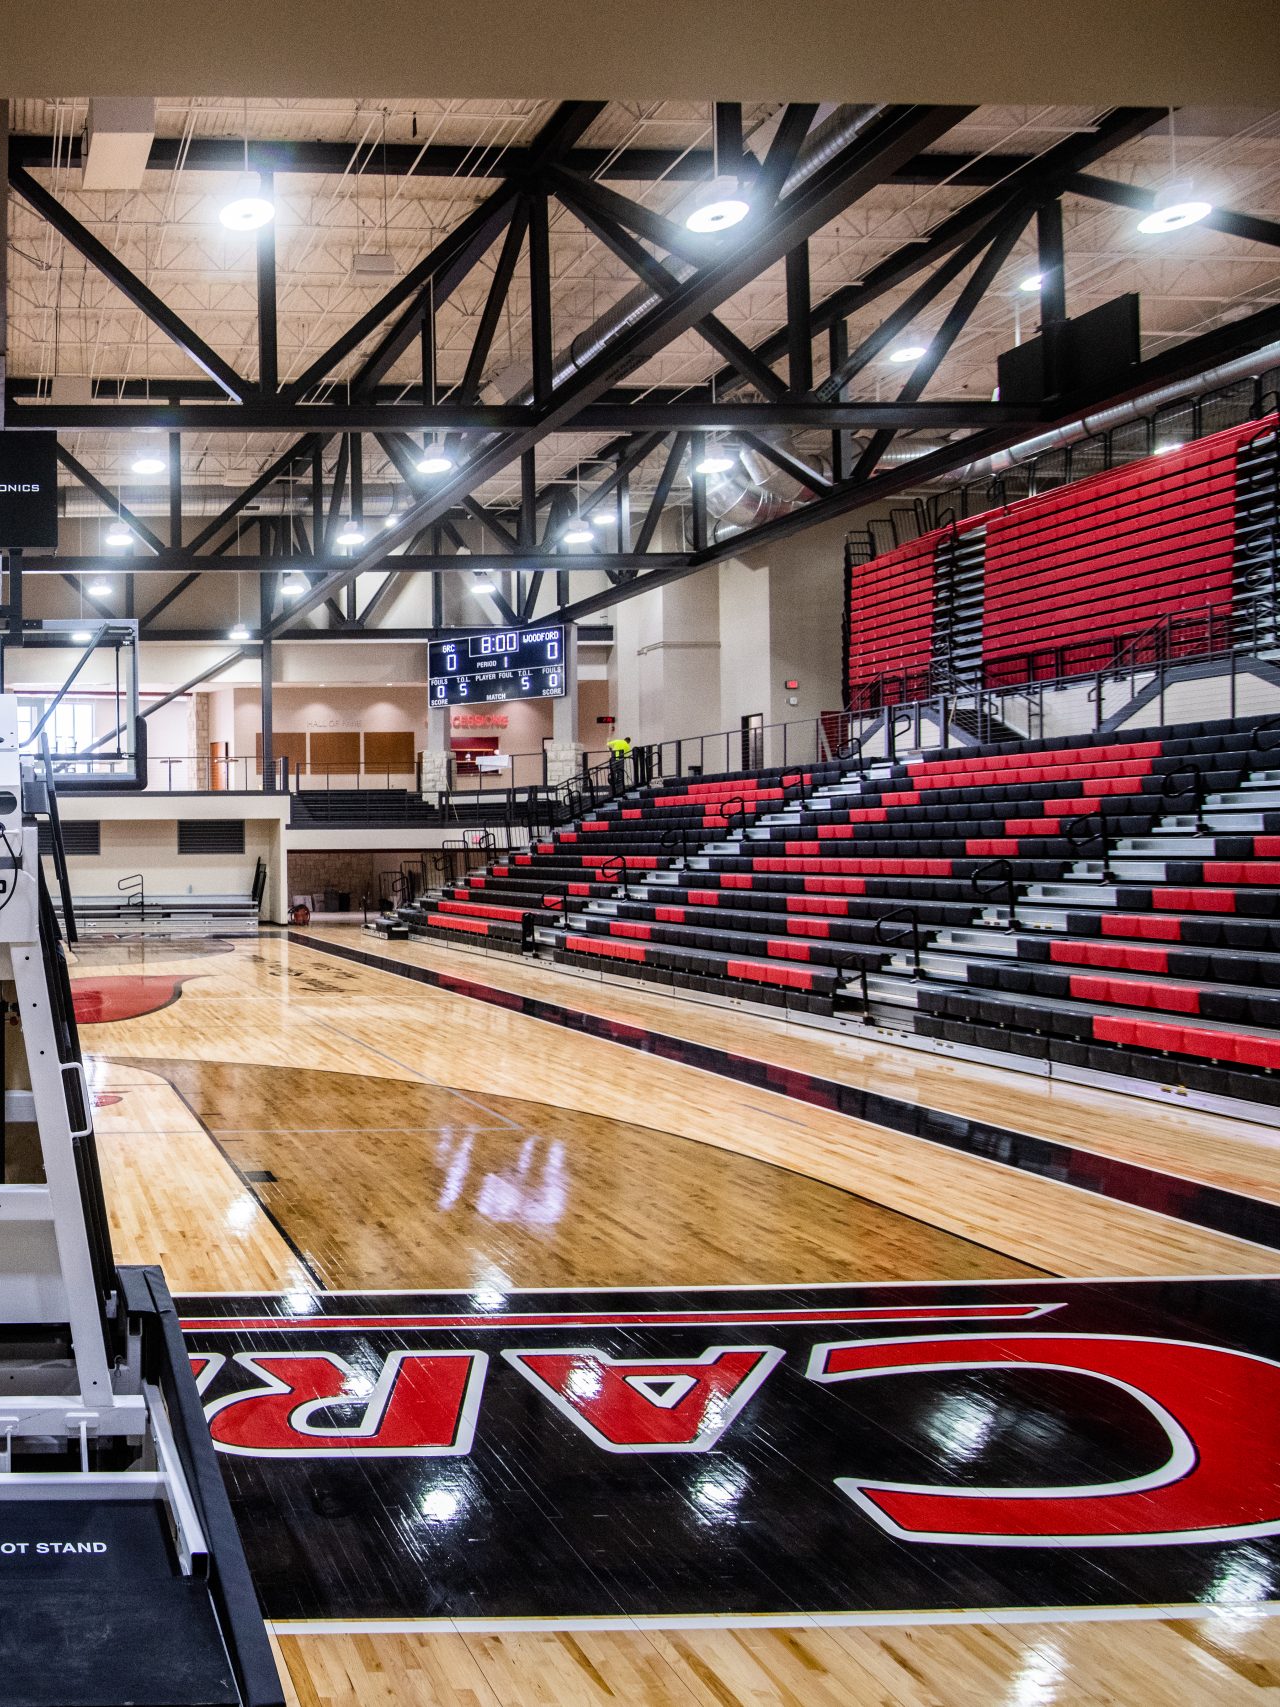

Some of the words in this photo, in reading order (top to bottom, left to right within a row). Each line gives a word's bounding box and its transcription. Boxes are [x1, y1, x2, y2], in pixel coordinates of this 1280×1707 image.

[481, 633, 517, 653] 8:00
[522, 631, 559, 643] WOODFORD
[442, 645, 455, 653] GRC
[547, 642, 558, 659] 0
[447, 654, 456, 670] 0
[476, 660, 497, 668] PERIOD
[542, 666, 561, 675] FOULS
[475, 673, 496, 681] PLAYER
[521, 676, 530, 690] 5
[549, 673, 558, 687] 0
[437, 685, 445, 698] 0
[459, 683, 468, 696] 5
[431, 698, 448, 706] SCORE
[36, 1542, 107, 1553] STAND
